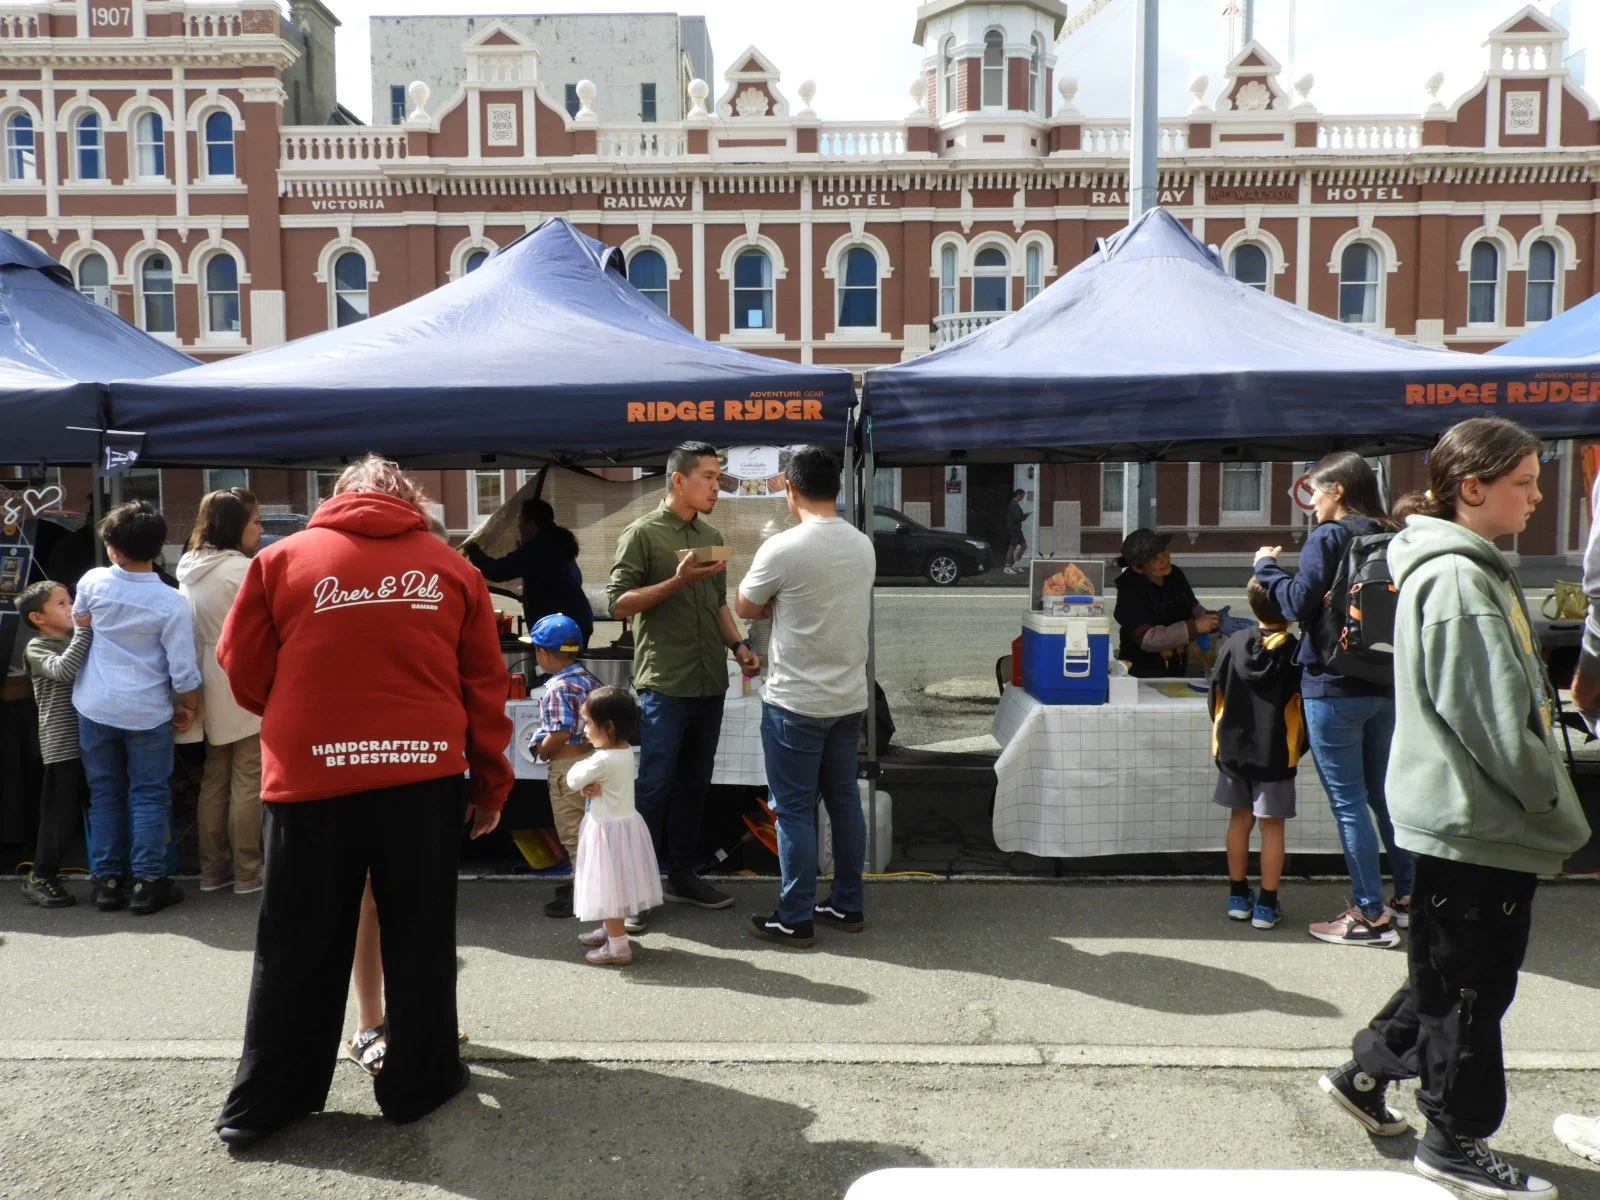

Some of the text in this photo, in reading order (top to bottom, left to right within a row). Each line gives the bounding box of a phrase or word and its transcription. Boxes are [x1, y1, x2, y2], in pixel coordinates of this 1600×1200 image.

[91, 7, 130, 26] 1907
[312, 194, 891, 210] VICTORIA RAILWAY HOTEL
[1092, 187, 1404, 204] RAIAY HOTEL
[1233, 189, 1294, 201] WATSON
[1405, 383, 1498, 405] RIDGE
[627, 399, 824, 422] RIDGE RYDER
[313, 570, 443, 609] Diner & Deli
[312, 740, 448, 756] HANDCRAFTED TO
[326, 752, 437, 767] BE DESTROYED
